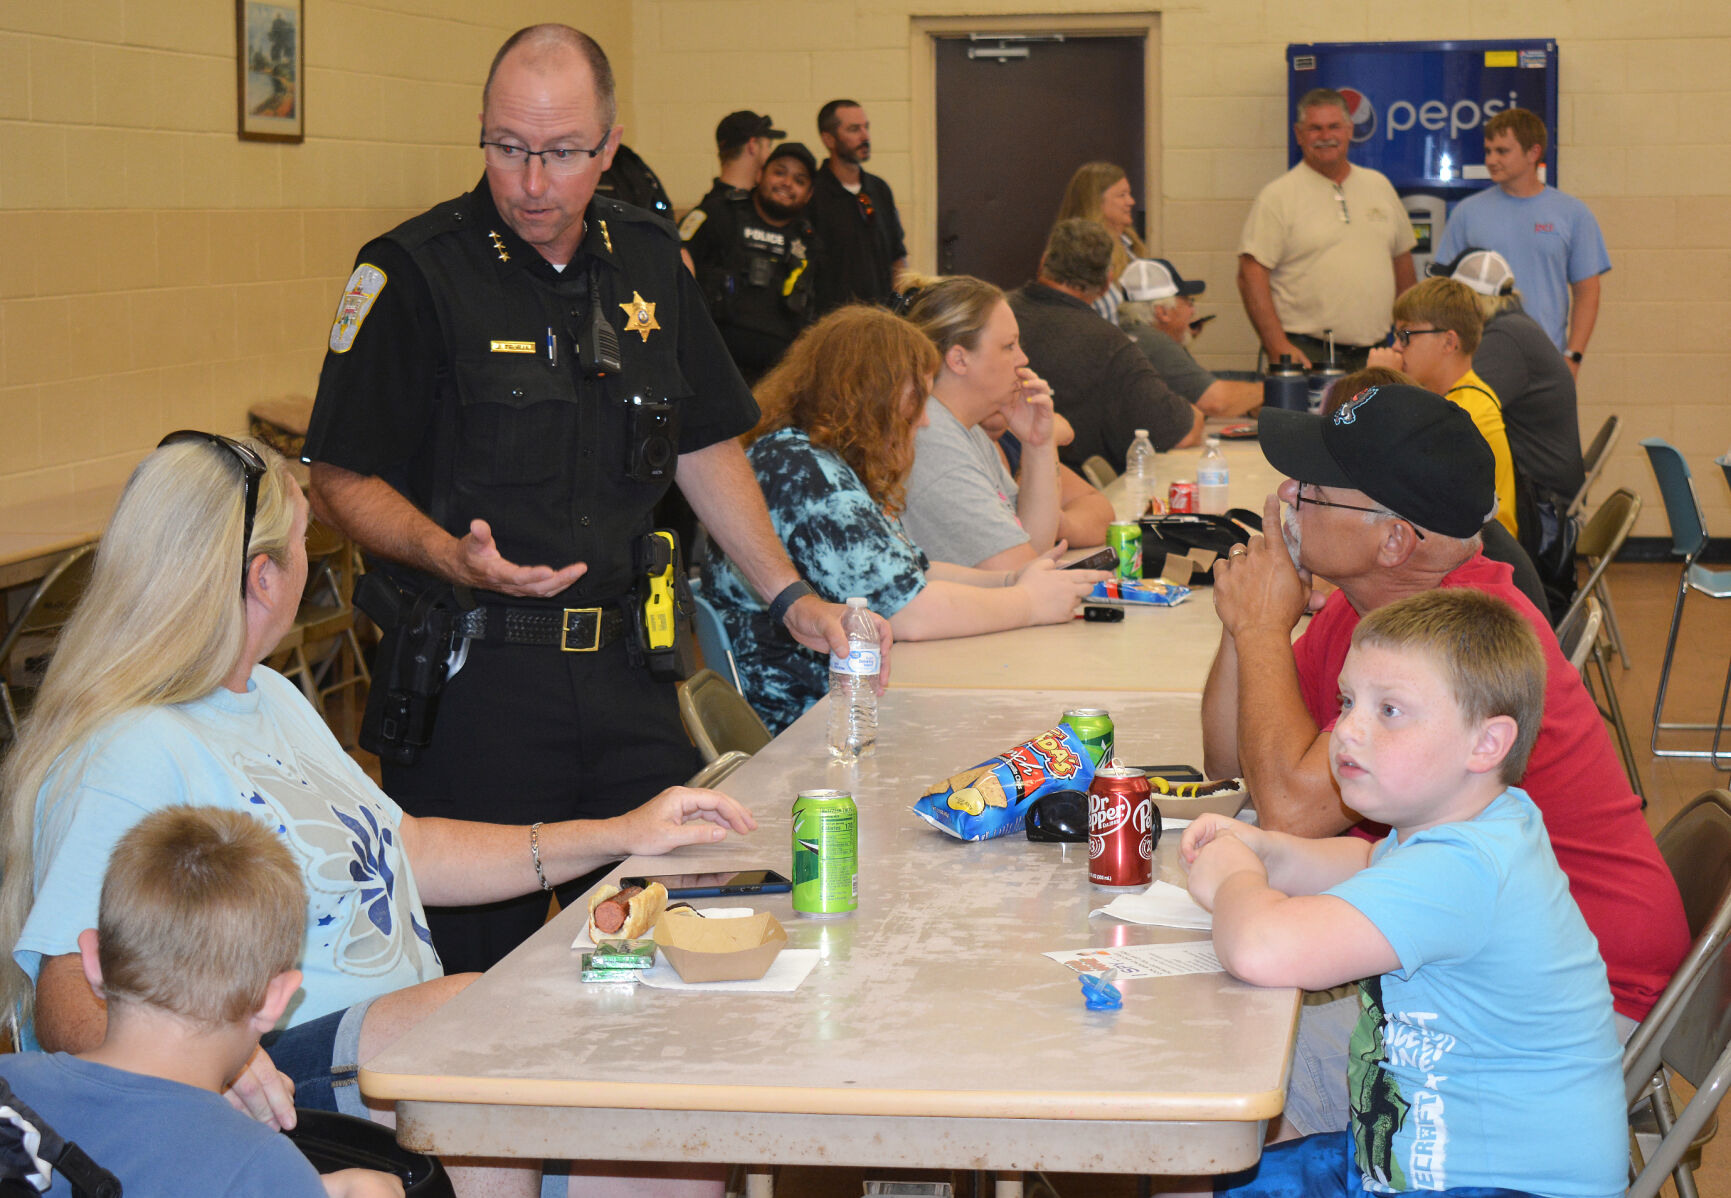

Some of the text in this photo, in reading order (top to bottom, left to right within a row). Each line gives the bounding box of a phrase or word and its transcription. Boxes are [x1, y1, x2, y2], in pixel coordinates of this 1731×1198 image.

[743, 227, 785, 246] POLICE
[1005, 748, 1045, 777] nch
[1090, 794, 1110, 813] Dr
[1413, 1094, 1438, 1189] ECRAFT
